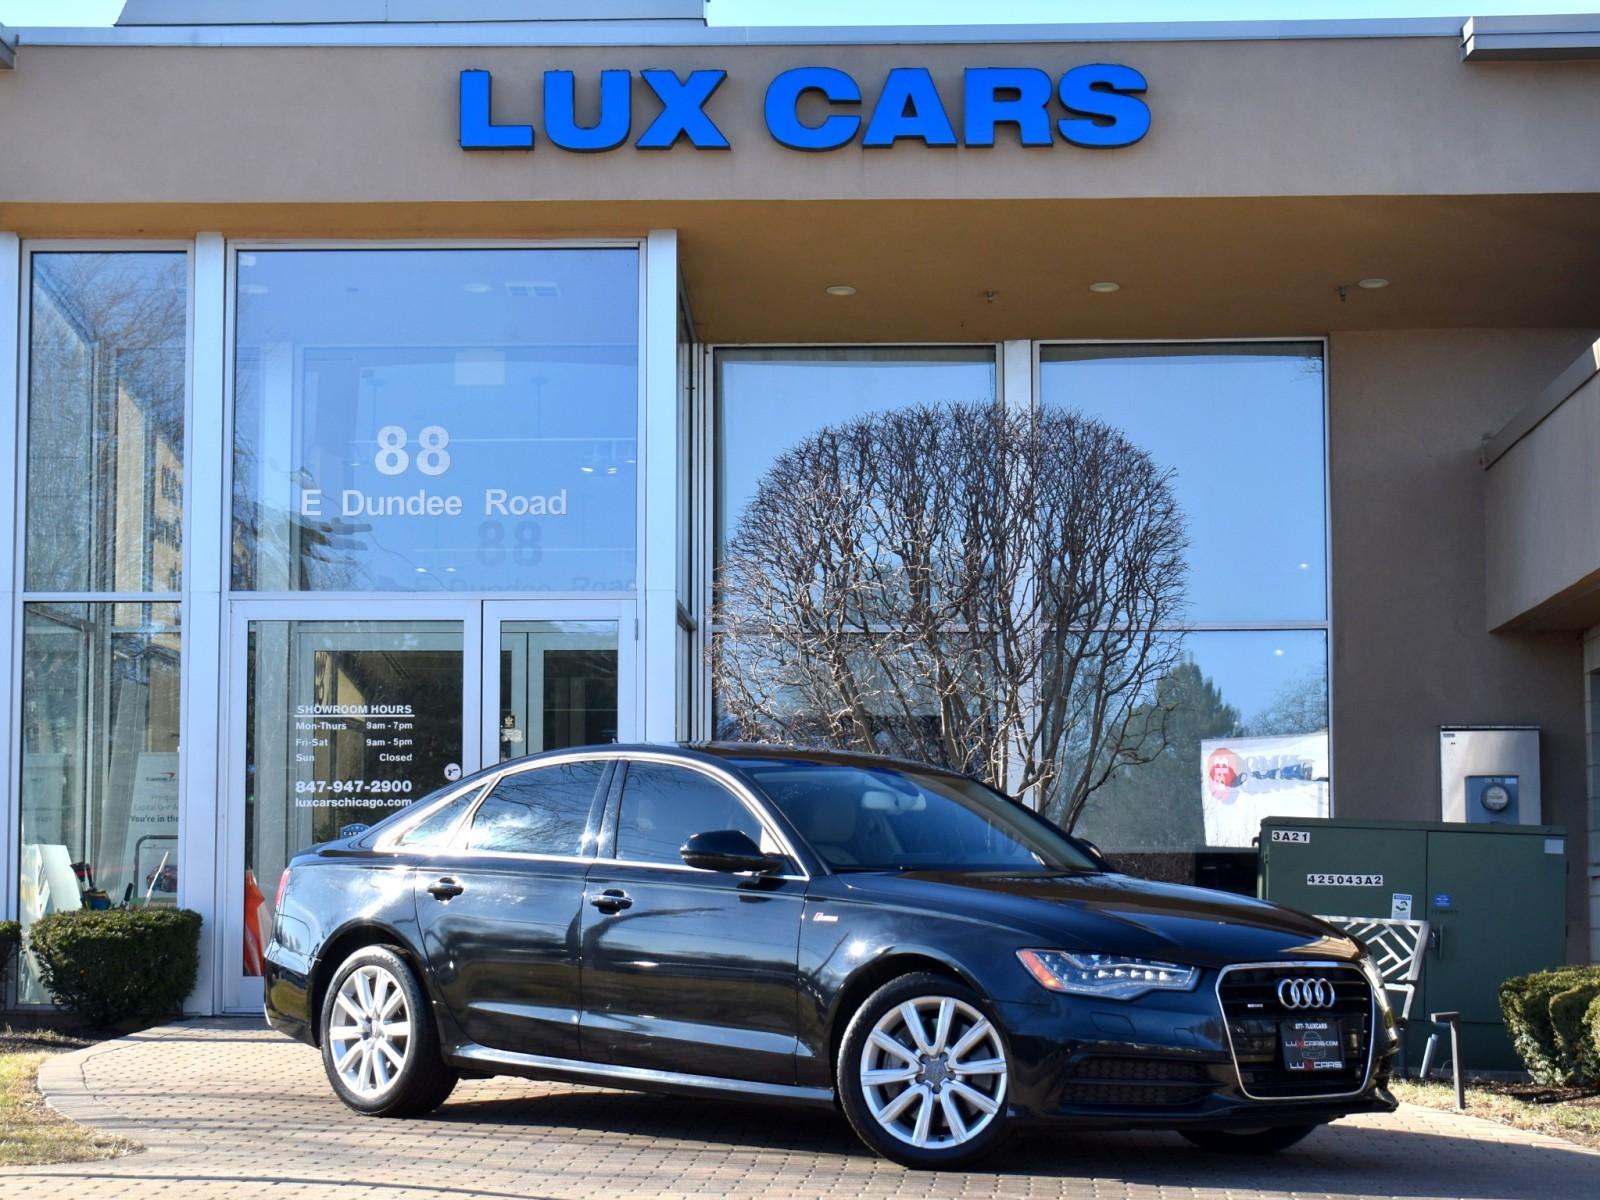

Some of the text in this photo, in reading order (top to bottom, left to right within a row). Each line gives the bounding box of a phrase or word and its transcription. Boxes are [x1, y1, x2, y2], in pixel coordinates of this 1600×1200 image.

[459, 63, 1152, 151] LUX CARS
[374, 425, 451, 476] 88
[301, 487, 568, 517] E Dundee Road
[297, 704, 413, 714] SHOWROOM HOURS
[295, 721, 347, 730] Mon-Thurs
[366, 721, 386, 730] 9am
[393, 721, 413, 731] 7pm
[295, 738, 329, 747] Fri-Sat
[366, 738, 386, 747] 9am
[393, 738, 413, 748] 5pm
[295, 752, 413, 762] Sun Closed
[295, 780, 413, 793] 847-947-2900
[295, 797, 412, 809] luxcarschicago.com
[1272, 831, 1308, 842] 3A21
[1308, 874, 1382, 885] 425043A2
